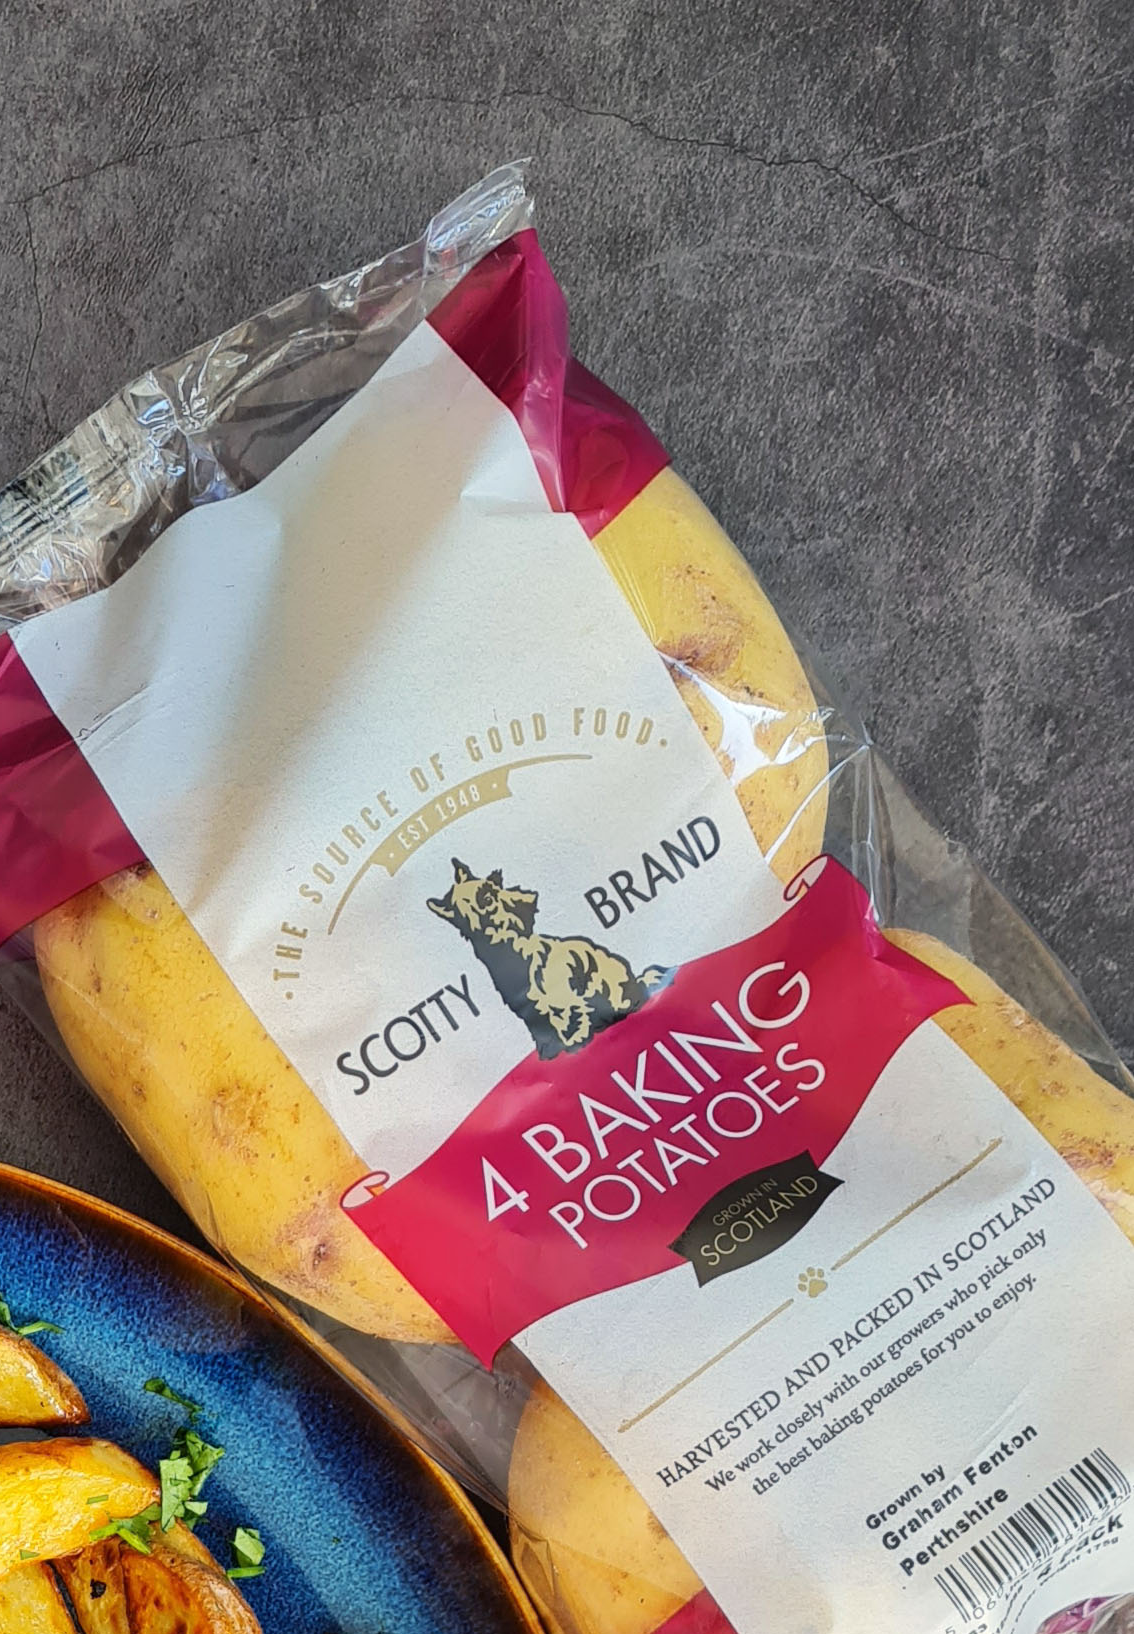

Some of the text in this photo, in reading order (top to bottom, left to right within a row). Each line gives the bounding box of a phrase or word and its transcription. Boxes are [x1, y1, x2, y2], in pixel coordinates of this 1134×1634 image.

[273, 921, 308, 981] THE
[299, 790, 398, 904] SOURCE
[409, 753, 446, 793] OF
[465, 712, 547, 762] GOOD
[397, 784, 482, 851] EST 1948
[336, 815, 721, 1096] SCOTTY BRAND
[480, 961, 811, 1222] 4 BAKING
[549, 1043, 827, 1250] POTATOES
[700, 1175, 818, 1266] SCOTLAND
[713, 1179, 779, 1226] GROWN IN
[656, 1177, 1056, 1488] HARVESTED AND PACKED IN SCOTLAND
[704, 1226, 1048, 1493] We work closely with our growers who pick only
[752, 1272, 1038, 1496] the best baking potatoes for you to enjoy.
[866, 1464, 946, 1530] Grown by
[882, 1424, 1038, 1550] Graham Fenton
[899, 1487, 1009, 1577] Perthshire
